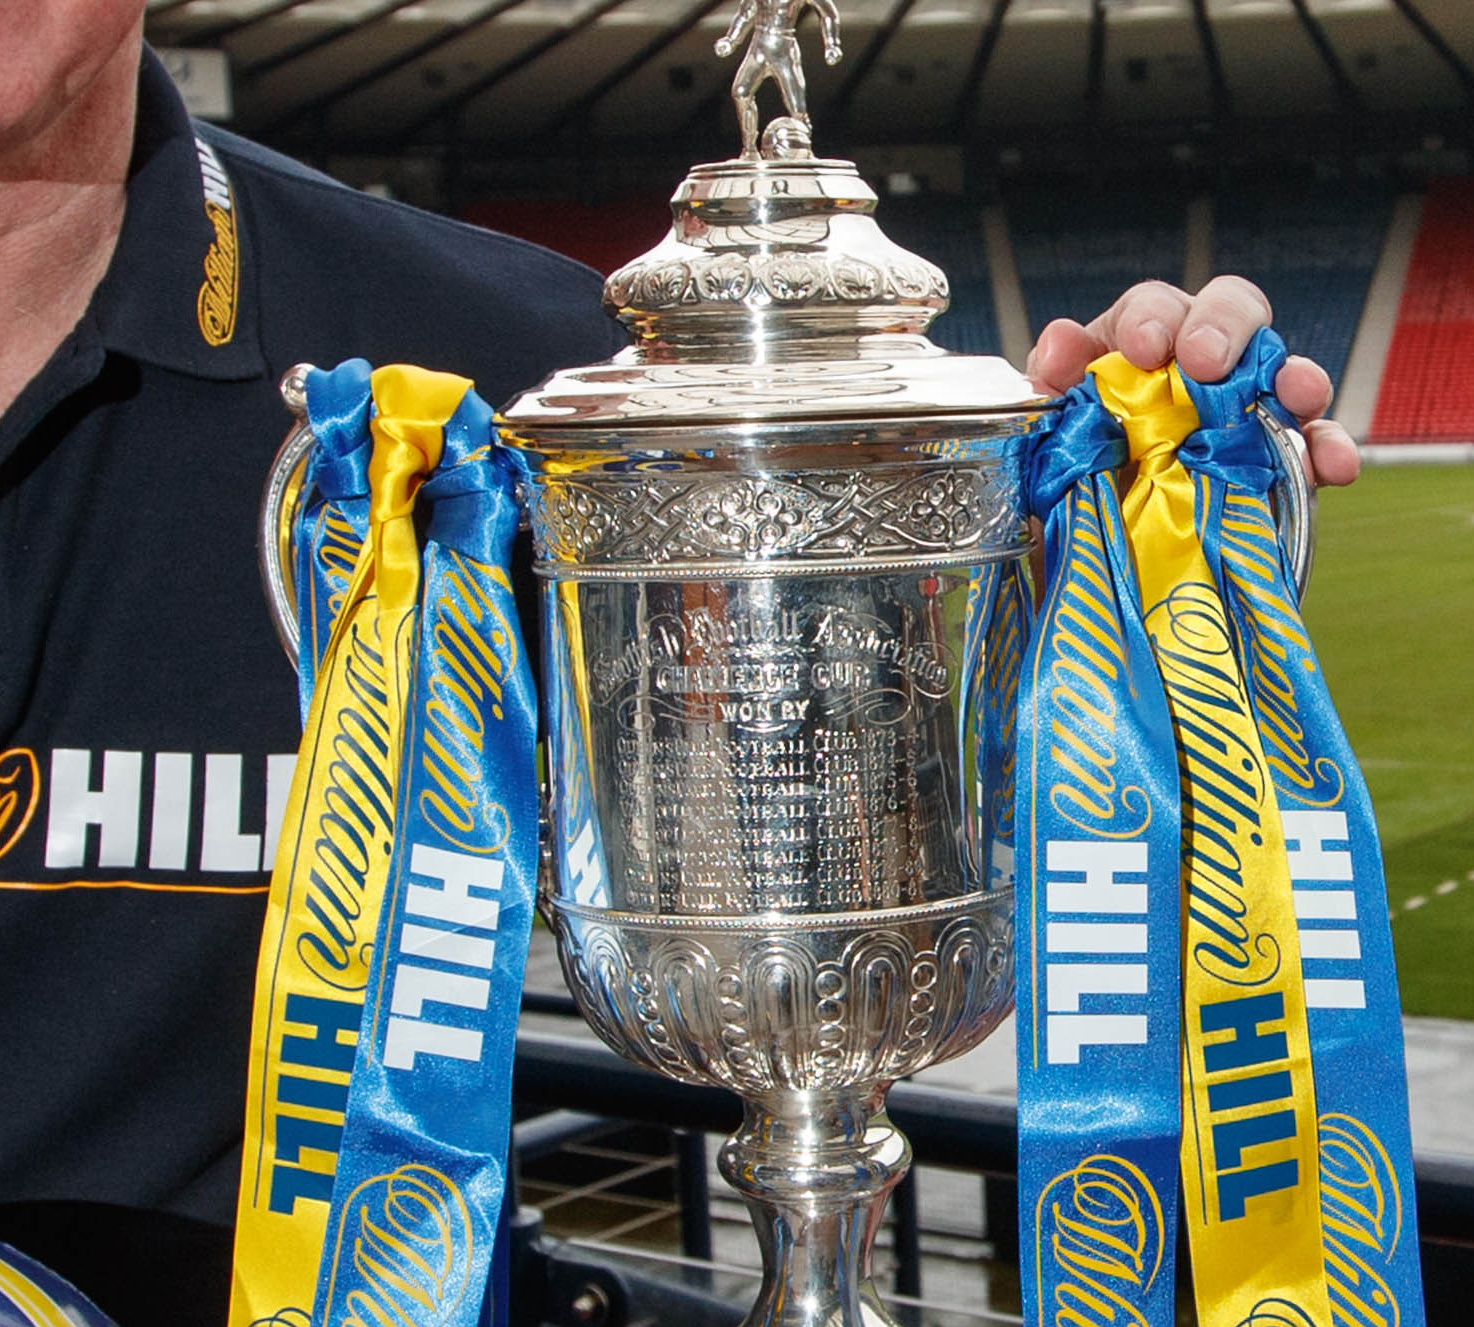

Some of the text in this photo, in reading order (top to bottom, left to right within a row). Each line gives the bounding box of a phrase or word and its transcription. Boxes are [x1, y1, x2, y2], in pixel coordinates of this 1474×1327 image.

[382, 550, 517, 1071] illiam HILL
[1047, 840, 1148, 1065] HILL
[1142, 581, 1302, 1225] William HILL
[268, 992, 364, 1216] HILL
